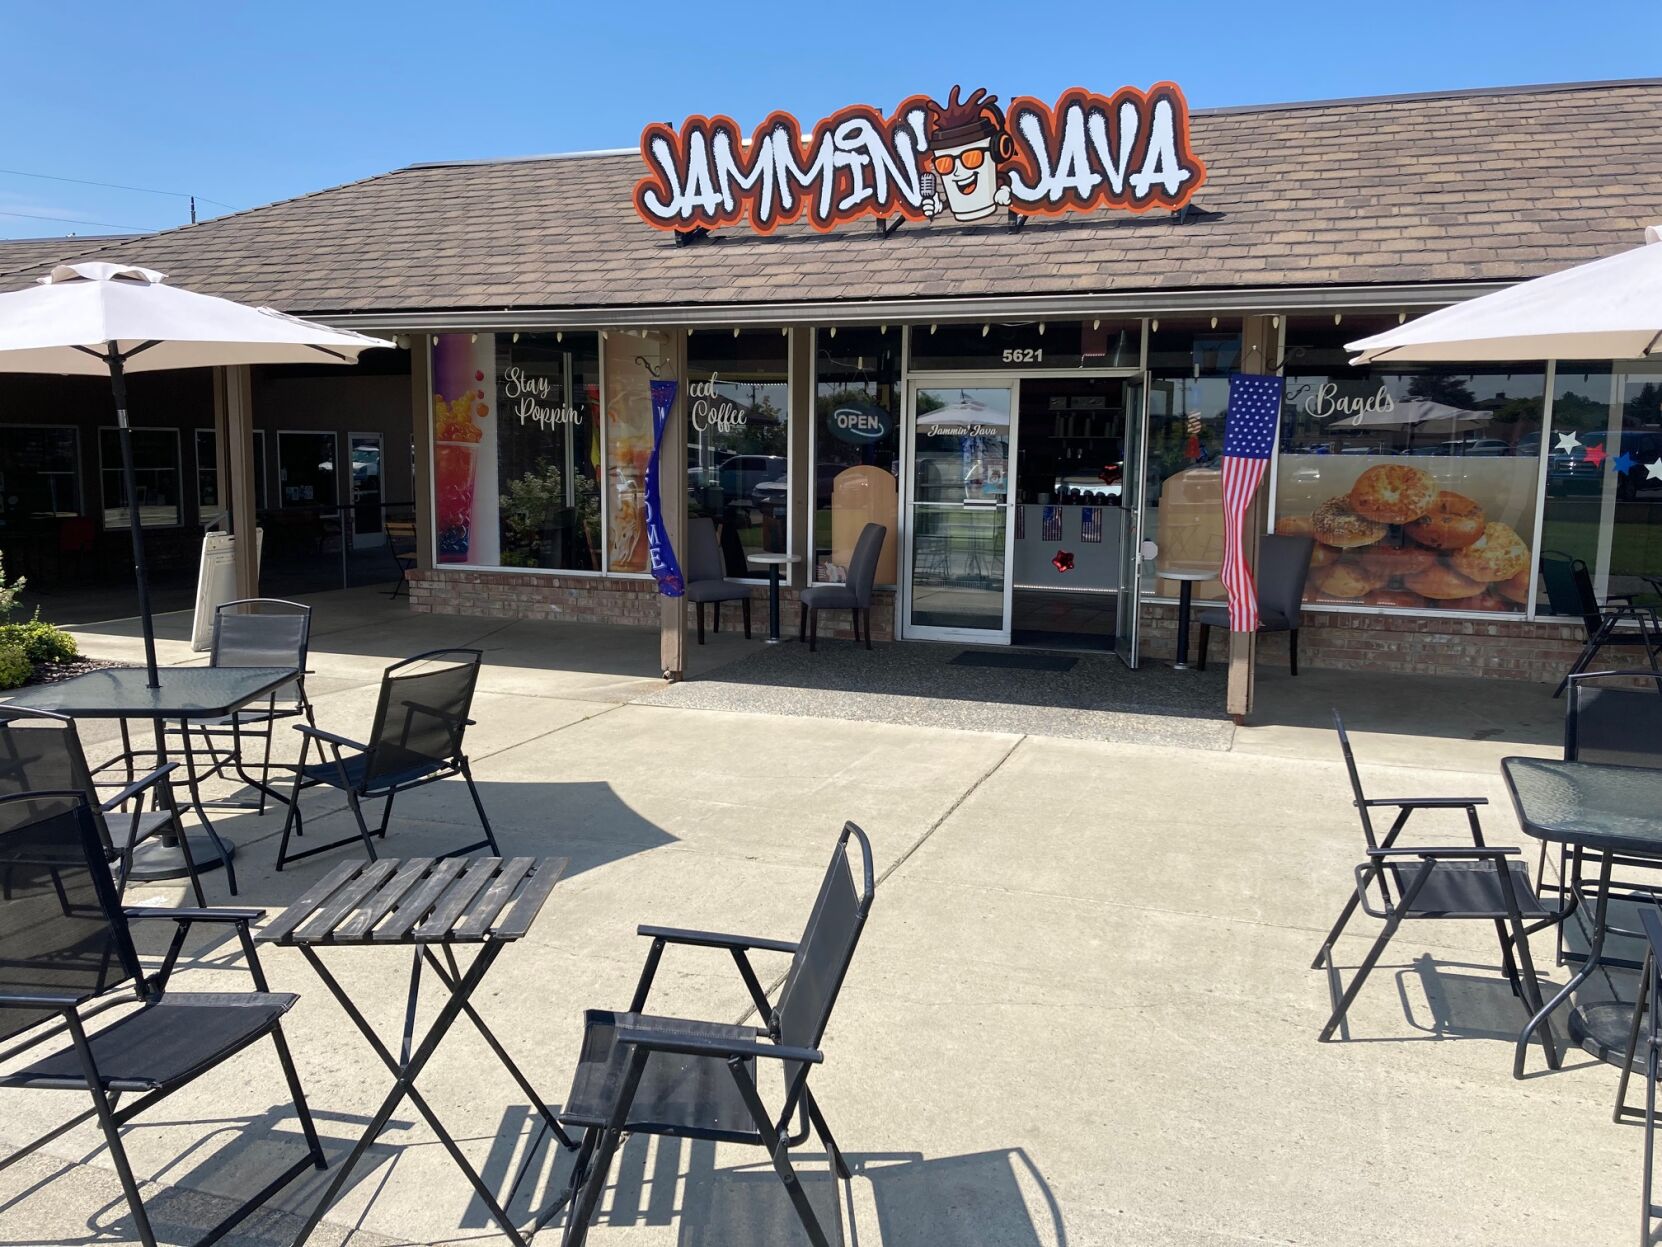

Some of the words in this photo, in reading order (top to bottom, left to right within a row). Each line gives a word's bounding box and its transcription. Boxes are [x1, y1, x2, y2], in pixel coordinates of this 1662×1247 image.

[644, 108, 929, 223] JAMMIN'
[1008, 99, 1192, 202] JAVA
[1002, 348, 1043, 363] 5621
[504, 366, 551, 399] Stay
[686, 371, 718, 399] ced
[514, 397, 585, 431] Poppin'
[691, 399, 748, 433] Coffee
[1305, 382, 1395, 426] Bagels
[837, 415, 879, 430] OPEN
[927, 424, 970, 437] Jammin'
[970, 424, 998, 437] Java
